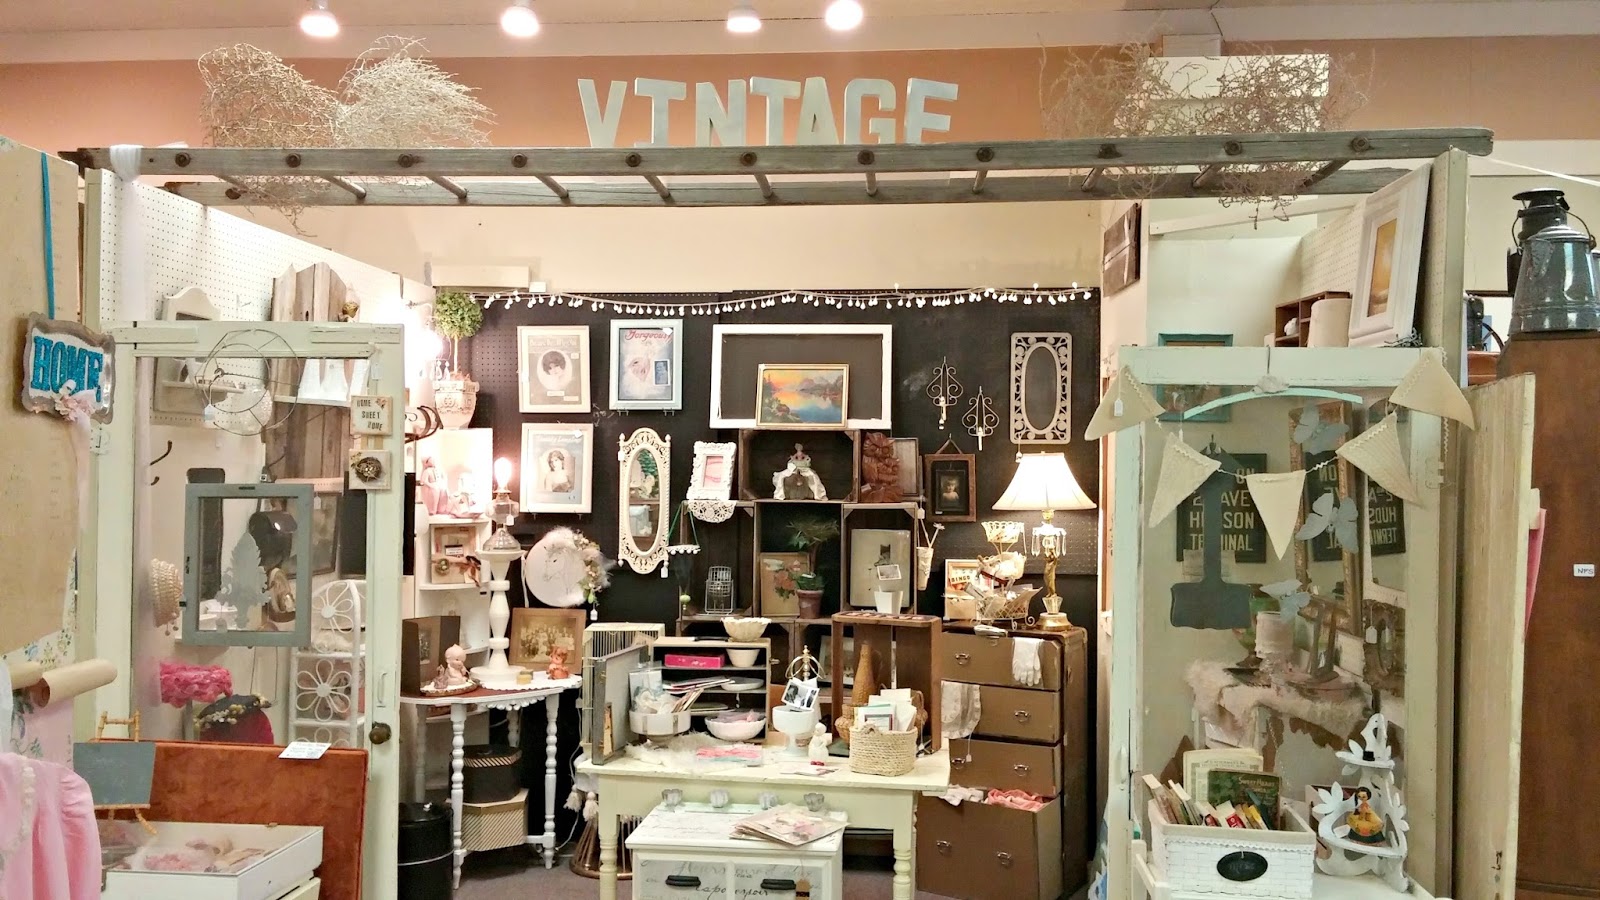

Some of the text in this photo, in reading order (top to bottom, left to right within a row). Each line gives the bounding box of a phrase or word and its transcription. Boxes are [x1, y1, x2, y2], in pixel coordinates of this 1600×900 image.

[577, 76, 959, 148] VINTAGE
[30, 335, 103, 403] HOME
[1189, 511, 1255, 529] HSON
